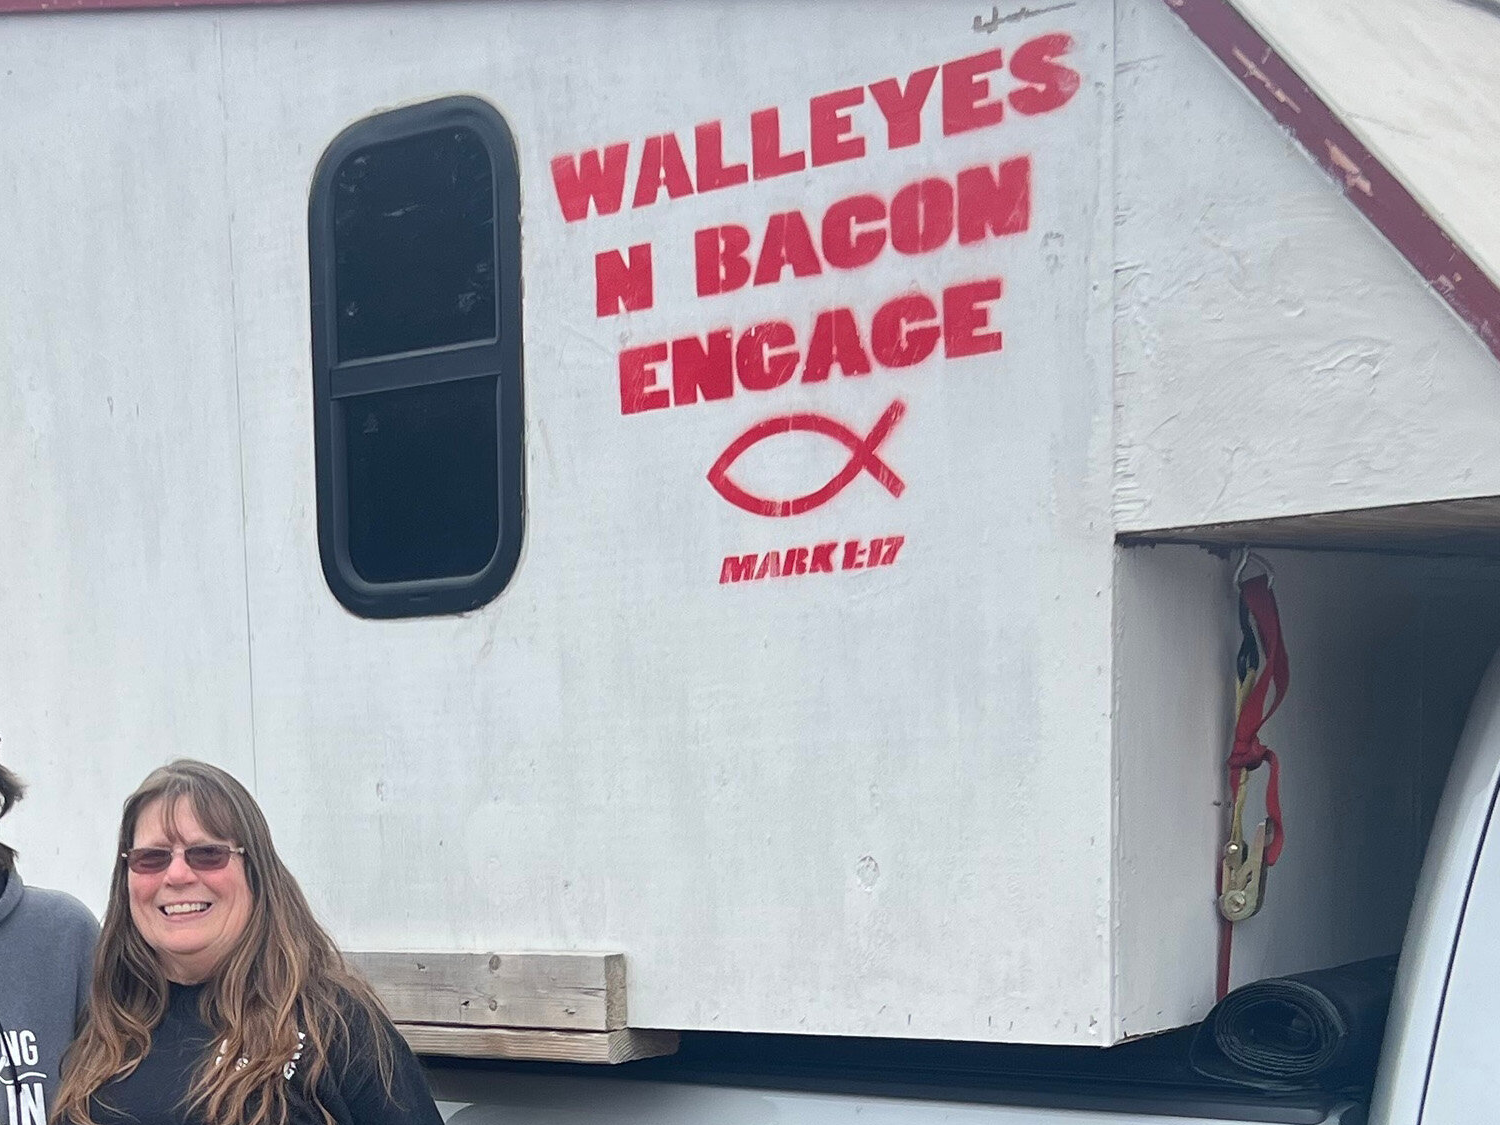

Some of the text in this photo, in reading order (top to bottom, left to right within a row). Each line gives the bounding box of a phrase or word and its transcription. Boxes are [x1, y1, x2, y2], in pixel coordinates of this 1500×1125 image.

[550, 33, 1081, 223] WALLEYES
[595, 155, 1032, 317] N BACON
[618, 278, 1002, 416] ENGAGE
[719, 535, 905, 584] MARK 1:17
